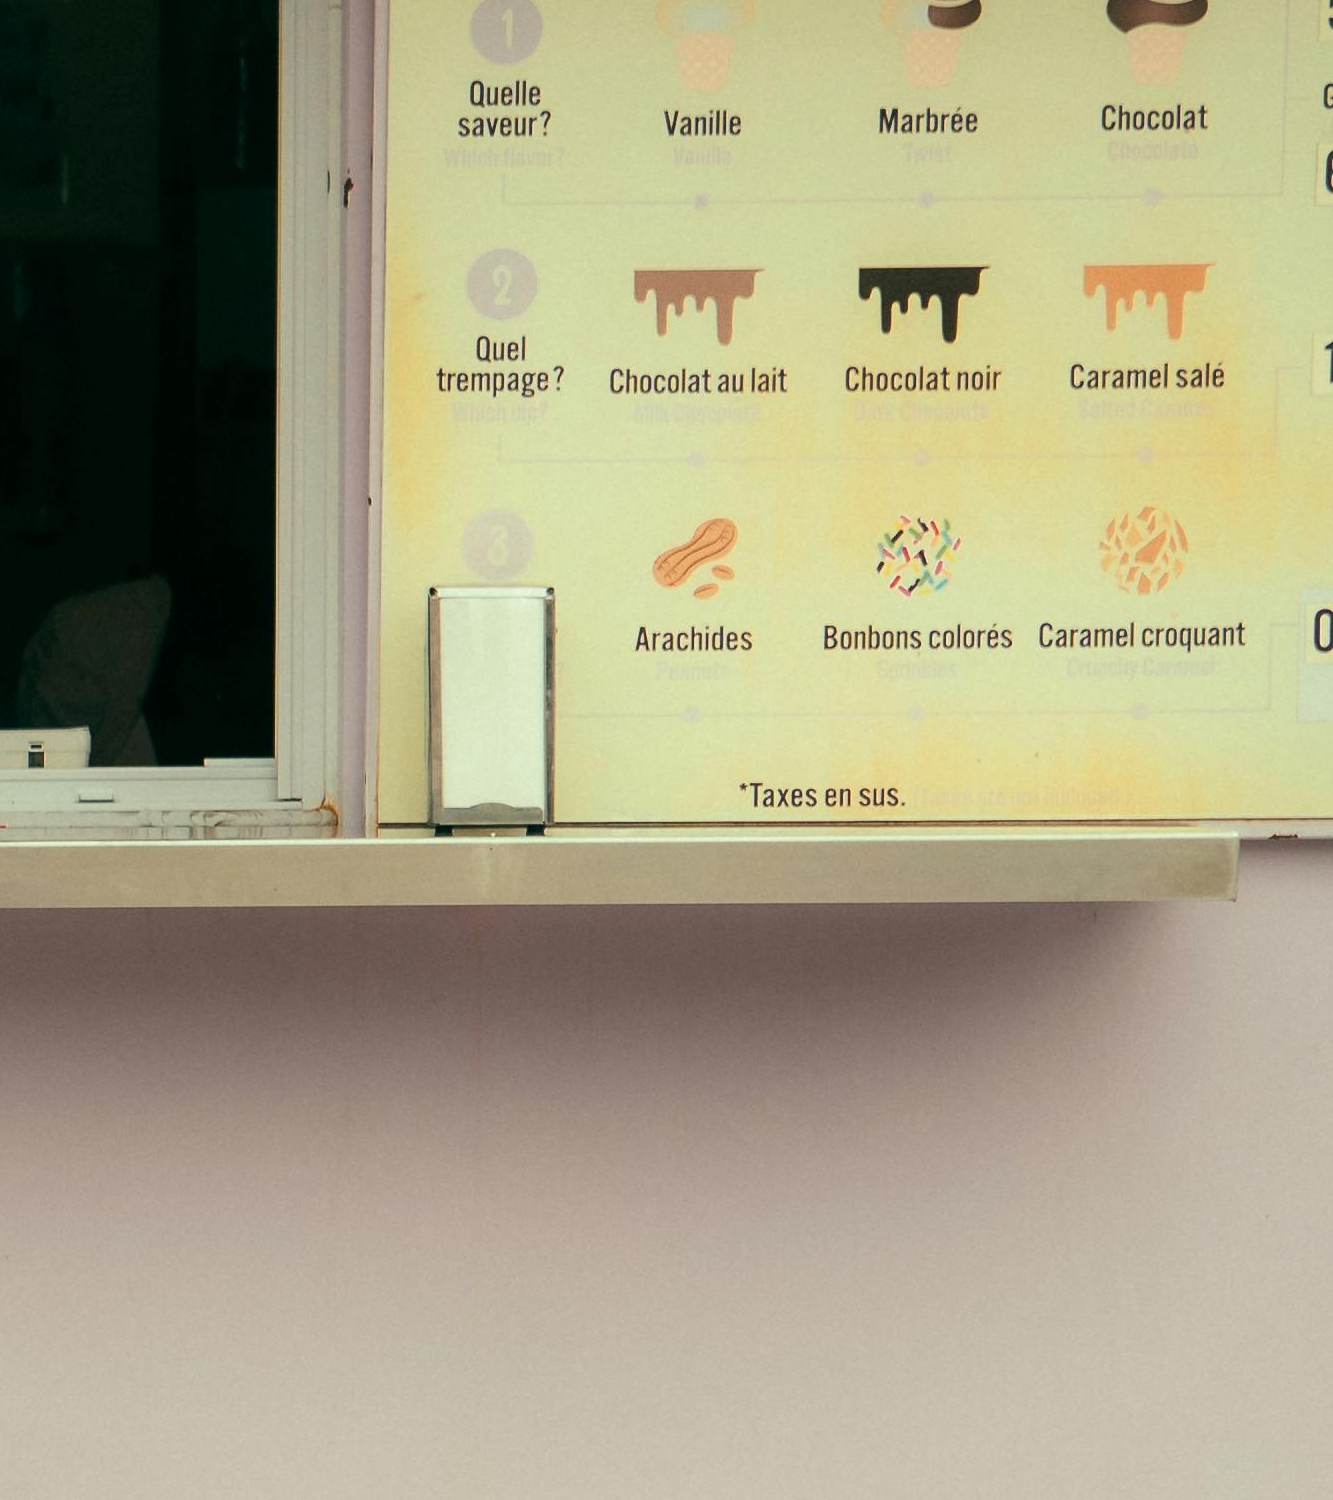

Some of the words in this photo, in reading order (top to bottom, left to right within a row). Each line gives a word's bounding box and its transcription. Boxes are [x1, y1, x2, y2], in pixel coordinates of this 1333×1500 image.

[469, 79, 541, 108] Quelle
[458, 110, 552, 138] saveur?
[663, 109, 742, 137] Vanille
[879, 107, 978, 134] Marbrée
[1101, 103, 1208, 131] Chocolat
[476, 335, 526, 364] Quel
[609, 368, 712, 395] Chocolat
[717, 373, 745, 394] au
[751, 366, 788, 393] lait
[845, 365, 951, 392] Chocolat
[956, 364, 1002, 391] noir
[1070, 362, 1169, 390] Caramel
[1175, 362, 1225, 389] salé
[634, 625, 753, 652] Arachides
[823, 624, 922, 650] Bonbons
[928, 623, 1013, 650] colorés
[1038, 621, 1135, 648] Caramel
[1141, 621, 1246, 653] croquant
[824, 787, 852, 808] en
[858, 787, 906, 807] sus.
